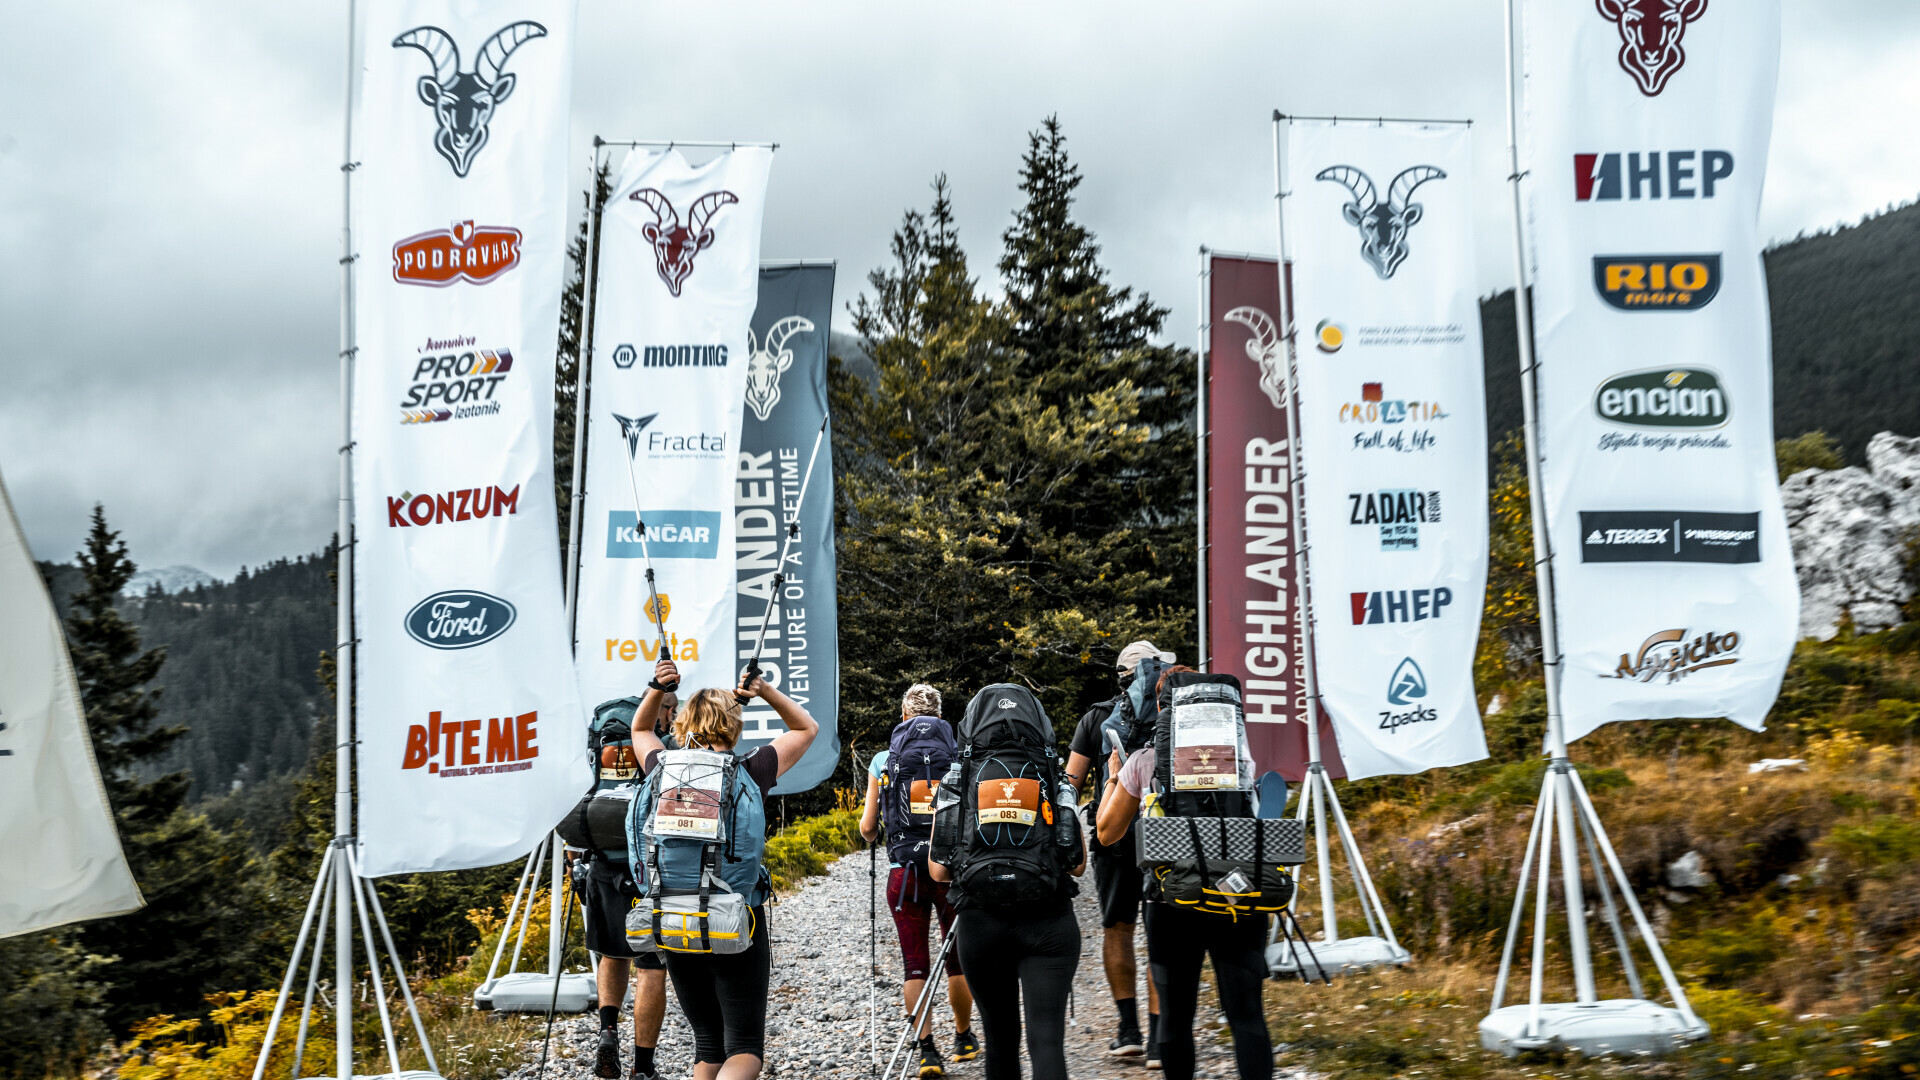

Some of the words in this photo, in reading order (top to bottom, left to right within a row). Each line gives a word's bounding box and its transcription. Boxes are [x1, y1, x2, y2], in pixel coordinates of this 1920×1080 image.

[1628, 149, 1735, 200] HEP
[403, 239, 509, 272] PODRAVKA
[1604, 262, 1710, 292] RIO
[411, 351, 476, 382] PRO
[400, 375, 507, 409] SPORT
[1600, 385, 1725, 417] encian
[1339, 401, 1450, 424] CROATIA
[649, 431, 727, 451] Fractal
[387, 484, 520, 528] KONZUM
[1605, 528, 1671, 545] TERREX
[784, 572, 804, 600] OF
[1245, 436, 1288, 724] HIGHLANDER
[427, 600, 488, 639] Ford
[1386, 587, 1453, 623] HEP
[1379, 704, 1438, 734] Zpacks
[486, 711, 539, 764] ME
[1197, 777, 1215, 785] 082
[677, 819, 694, 828] 081
[1000, 810, 1018, 819] 083
